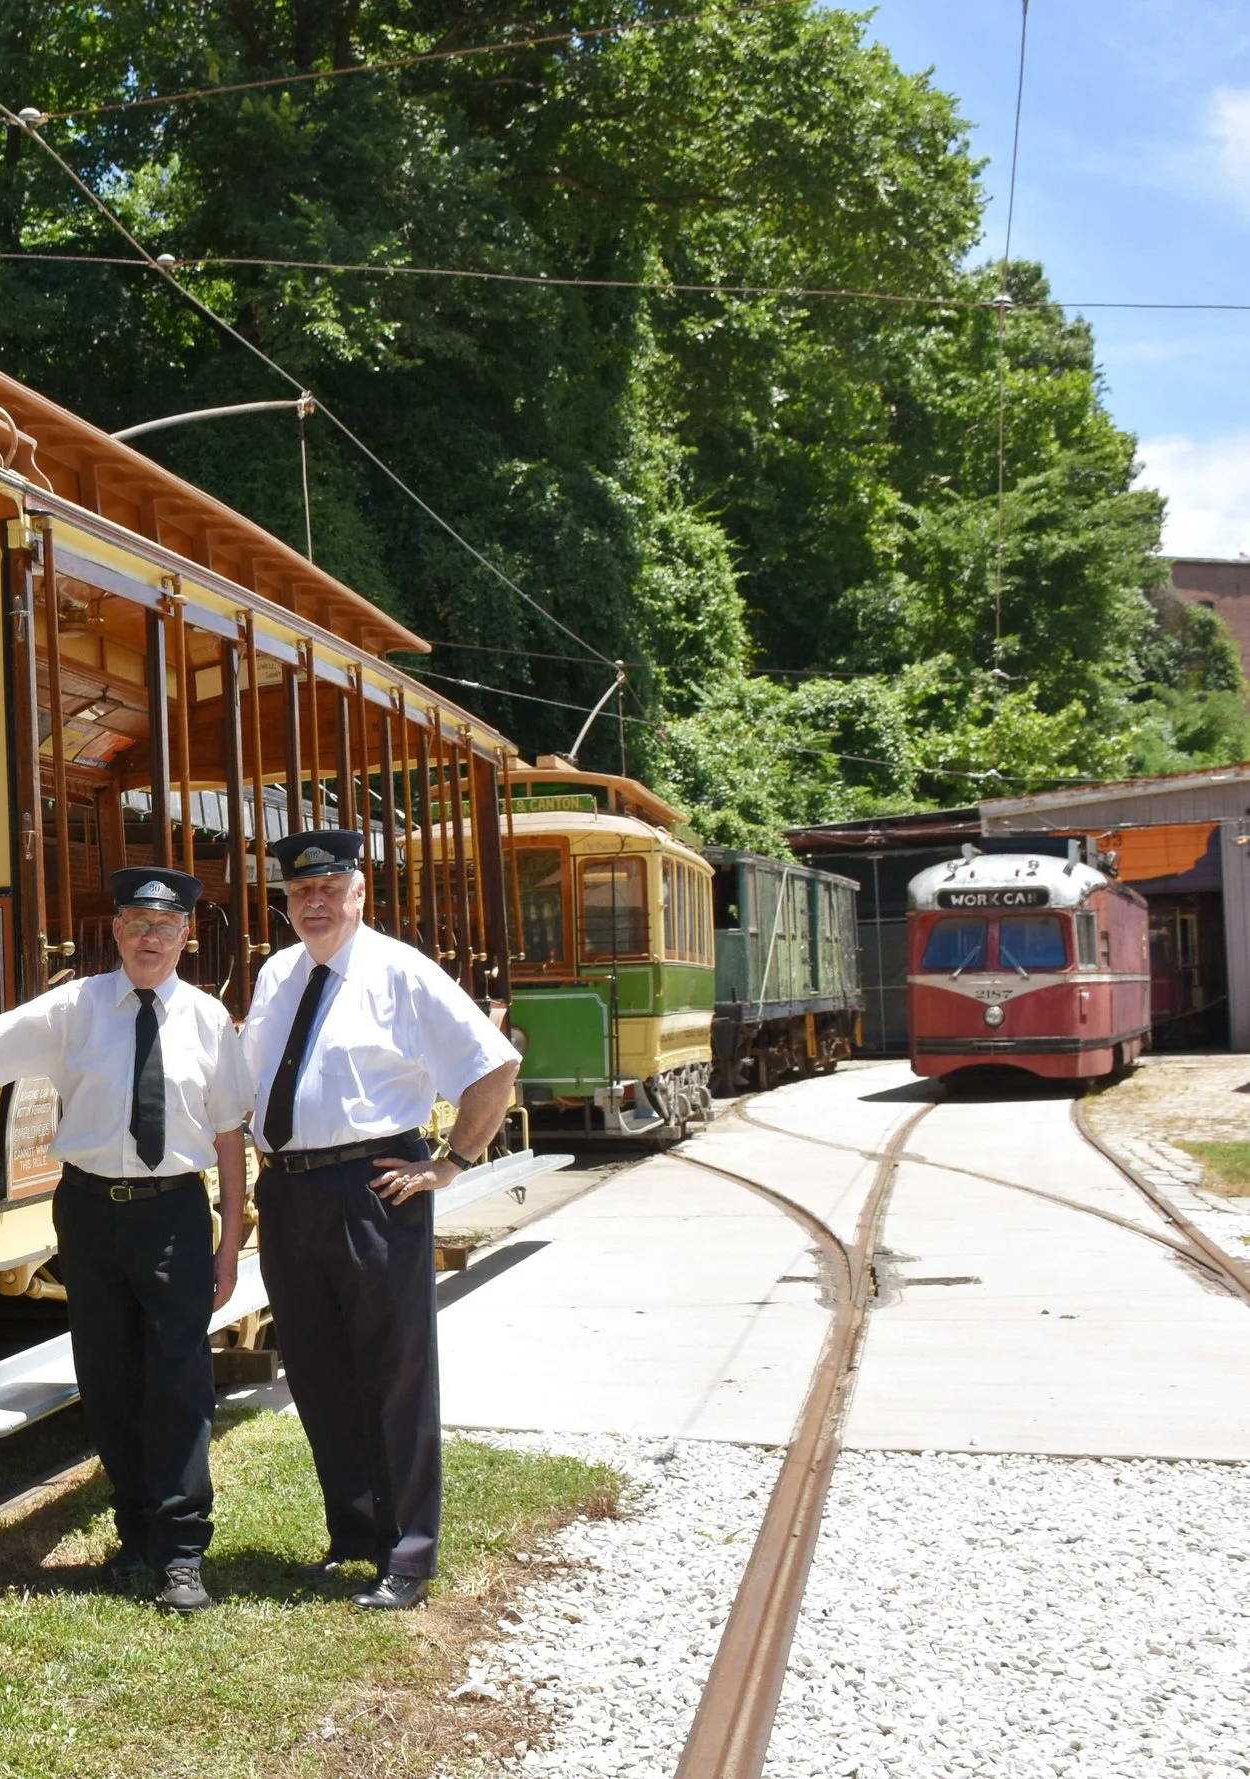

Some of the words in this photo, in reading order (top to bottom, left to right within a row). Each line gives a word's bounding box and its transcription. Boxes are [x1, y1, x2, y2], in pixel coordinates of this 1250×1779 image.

[516, 802, 527, 812] &
[529, 797, 584, 812] CANTON.
[950, 892, 1000, 907] WORK
[975, 989, 1014, 1000] 2187
[14, 1123, 50, 1141] EMPLOYEES
[14, 1147, 34, 1160] CANNOT
[20, 1160, 31, 1171] THIS
[32, 1156, 47, 1168] RULE
